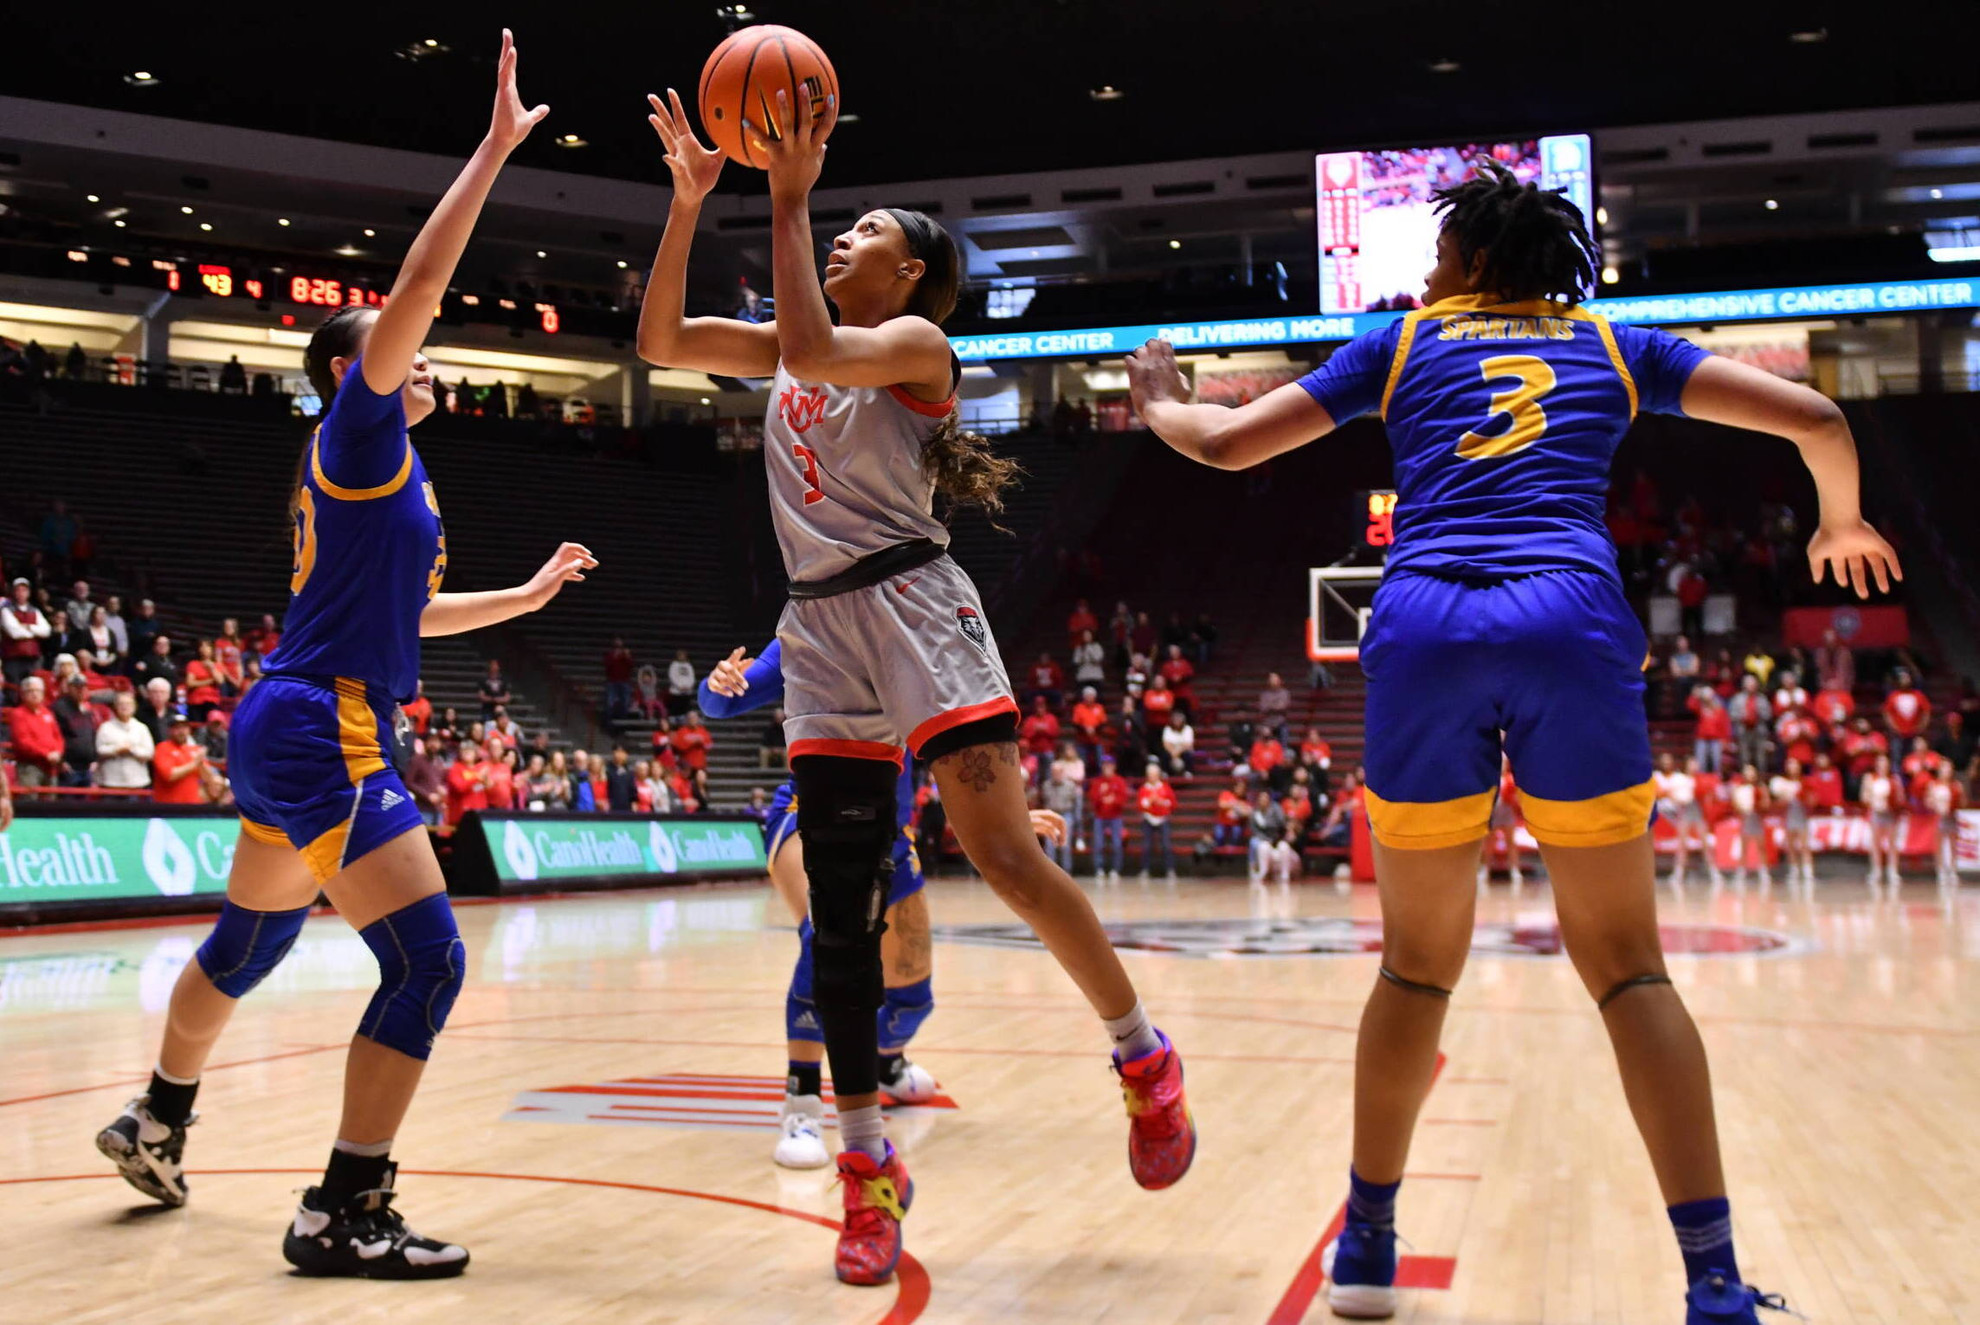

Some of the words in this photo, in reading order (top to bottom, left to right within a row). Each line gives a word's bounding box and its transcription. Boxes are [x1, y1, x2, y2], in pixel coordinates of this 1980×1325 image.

[202, 273, 232, 297] 43
[246, 279, 262, 298] 4
[292, 276, 342, 307] 8:26
[1588, 293, 1775, 322] COMPREHENSIVE
[1778, 288, 1875, 313] CANCER
[1878, 282, 1972, 307] CENTER
[542, 310, 559, 334] 0
[1157, 321, 1286, 345] DELIVERING
[1291, 317, 1355, 338] MORE
[1437, 315, 1575, 341] SPARTANS
[952, 336, 1032, 357] CANCER
[1036, 332, 1114, 352] CENTER
[1454, 354, 1557, 461] 3
